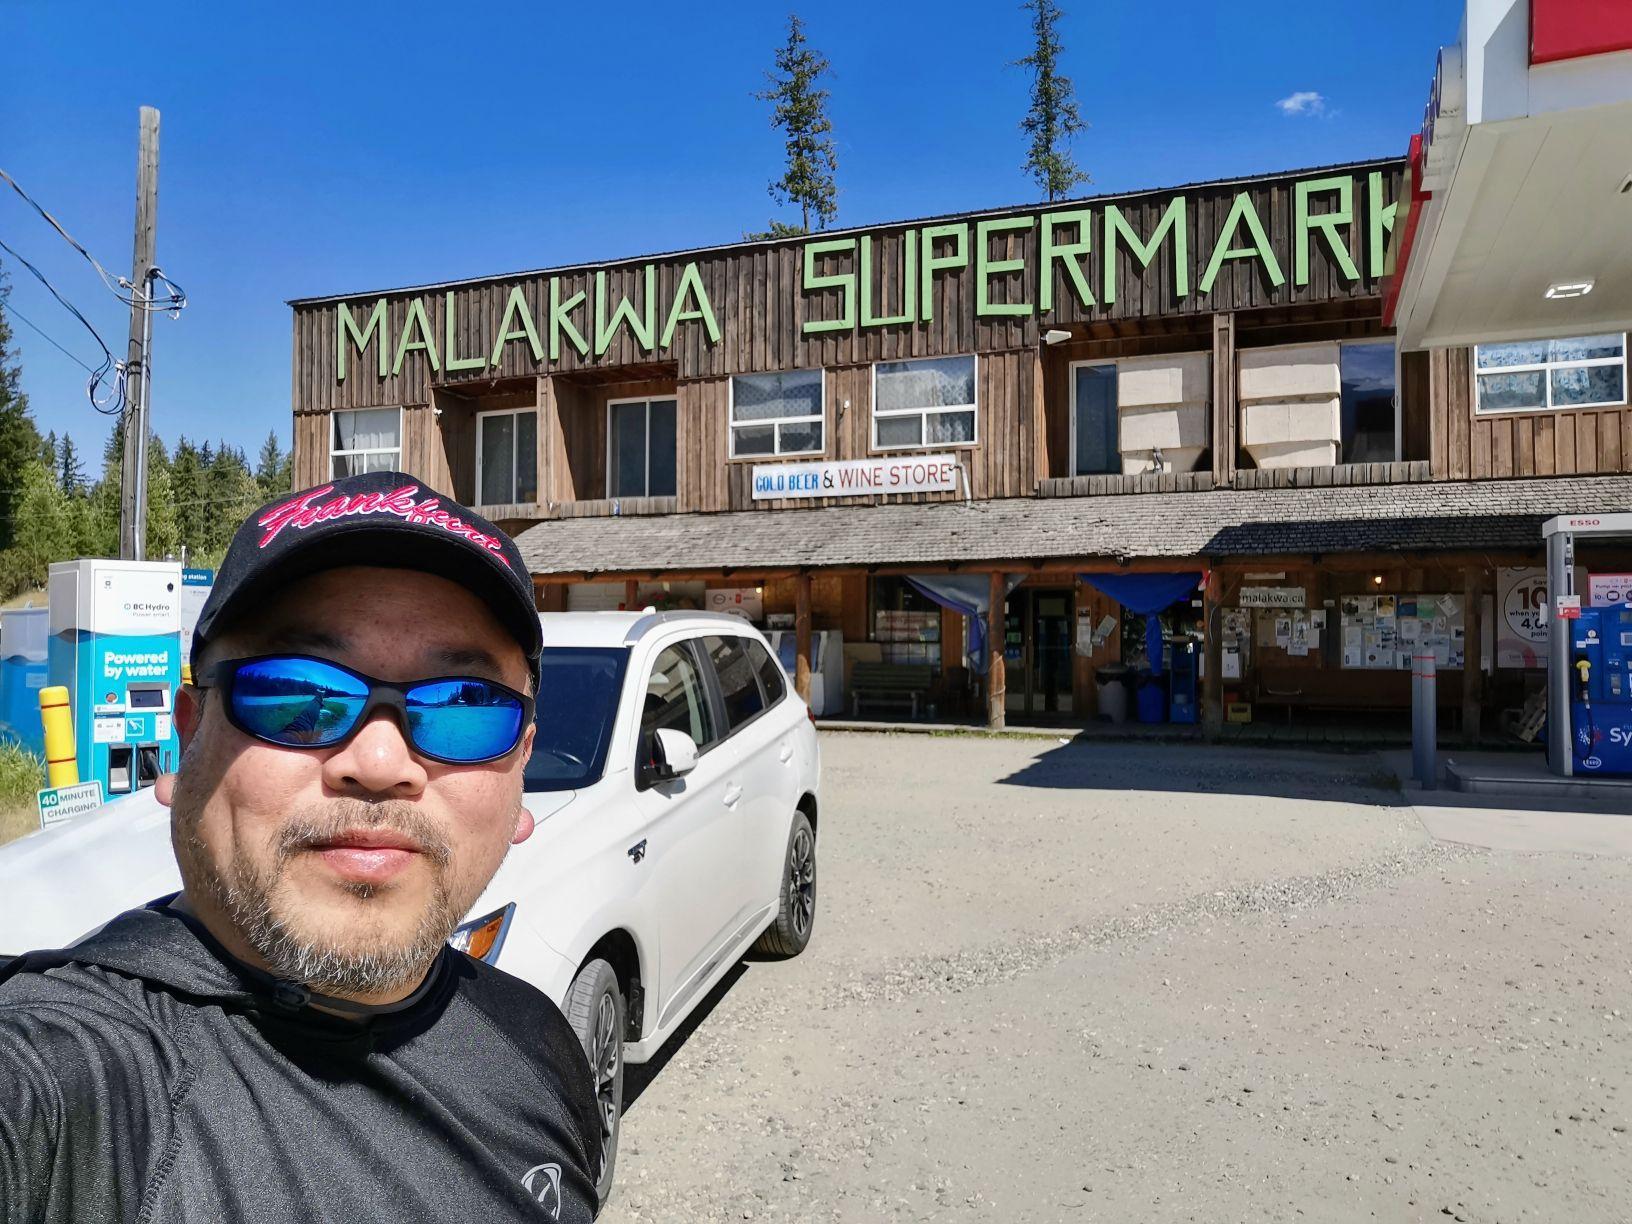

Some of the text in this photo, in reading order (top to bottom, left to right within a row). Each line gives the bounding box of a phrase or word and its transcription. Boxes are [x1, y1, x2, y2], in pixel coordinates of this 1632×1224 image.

[337, 261, 721, 380] MALAKWA
[756, 463, 951, 492] COLD BEER & WINE STORE
[1242, 594, 1304, 603] malakwa.ca
[145, 603, 170, 611] Hydro
[104, 651, 169, 665] Powered
[104, 664, 169, 680] by water
[41, 789, 96, 806] 40 MINUTE
[47, 802, 97, 818] CHARGING
